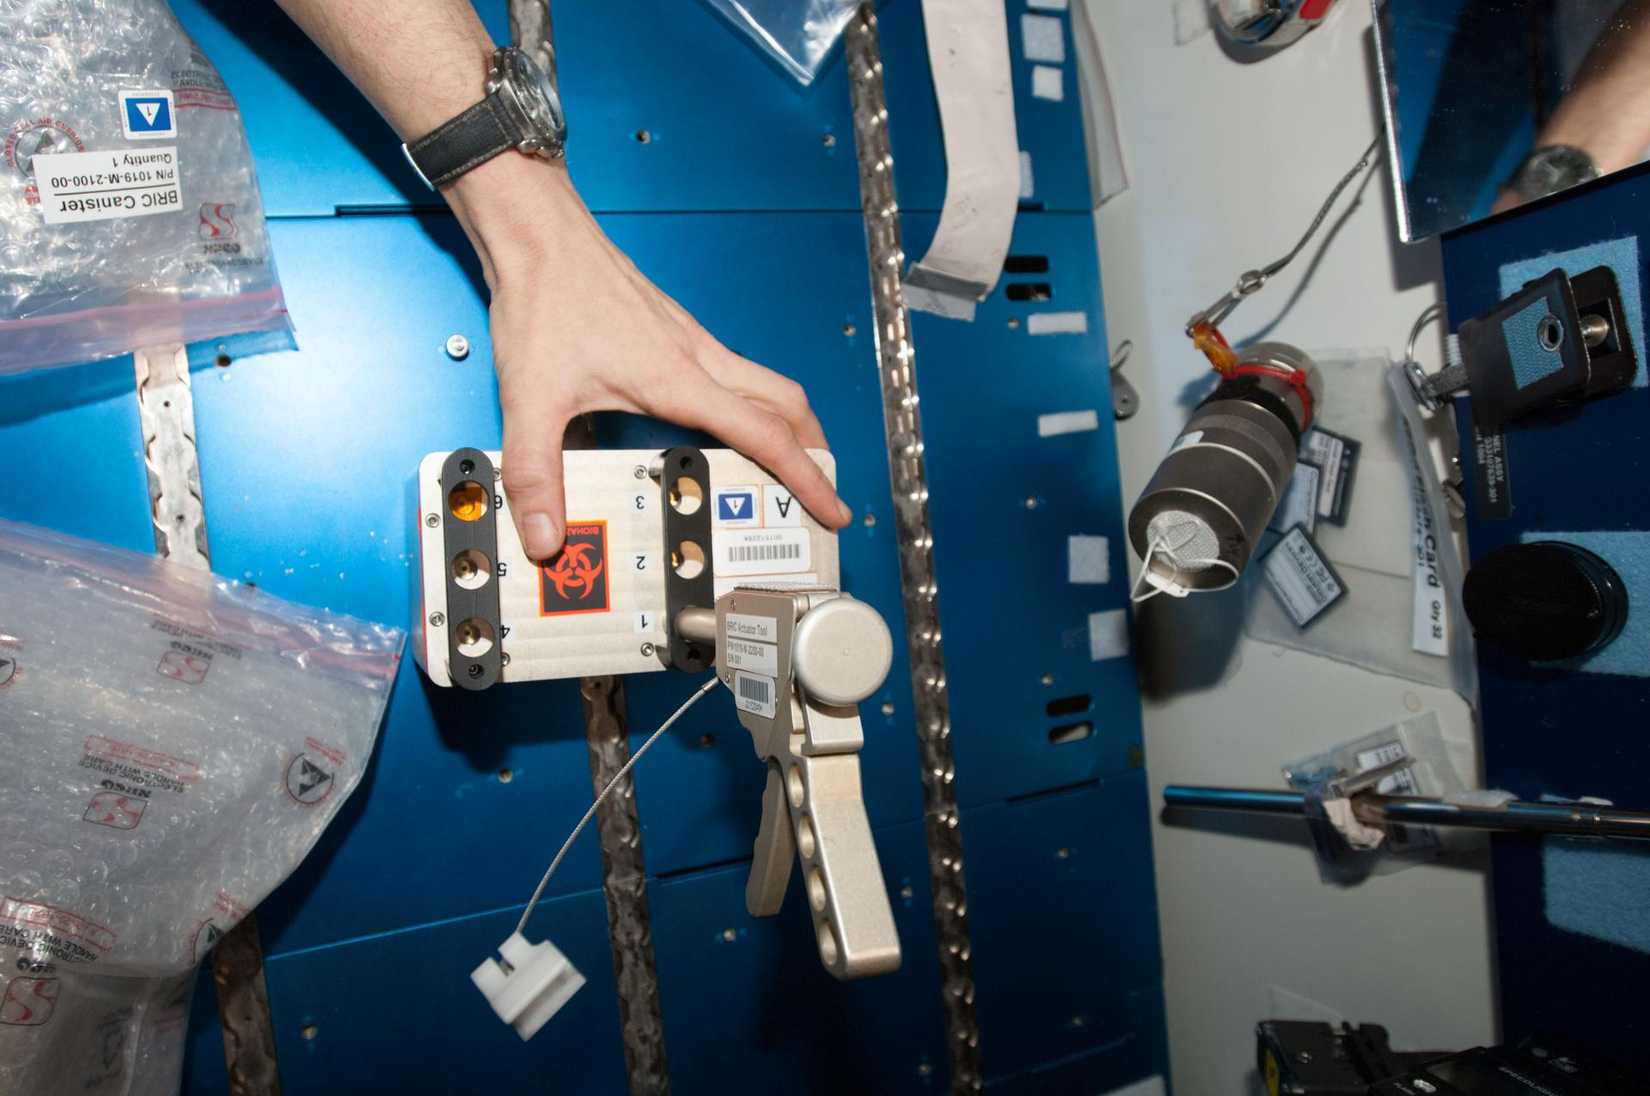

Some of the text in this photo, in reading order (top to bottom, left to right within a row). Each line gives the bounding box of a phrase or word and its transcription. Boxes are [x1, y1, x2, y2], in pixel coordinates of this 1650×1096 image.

[112, 152, 172, 168] Quantity 1
[51, 168, 174, 188] P/N 1019-M-2100-00
[60, 194, 136, 212] Canister
[142, 189, 178, 208] BRIC
[635, 495, 645, 510] 3
[775, 495, 792, 519] A
[567, 526, 600, 536] BIOHAZ
[636, 555, 646, 570] 2
[1425, 534, 1441, 588] Card
[498, 562, 508, 577] 5
[1431, 599, 1442, 622] Qty
[641, 614, 649, 629] 1
[501, 624, 511, 639] 4
[757, 624, 768, 636] Tool
